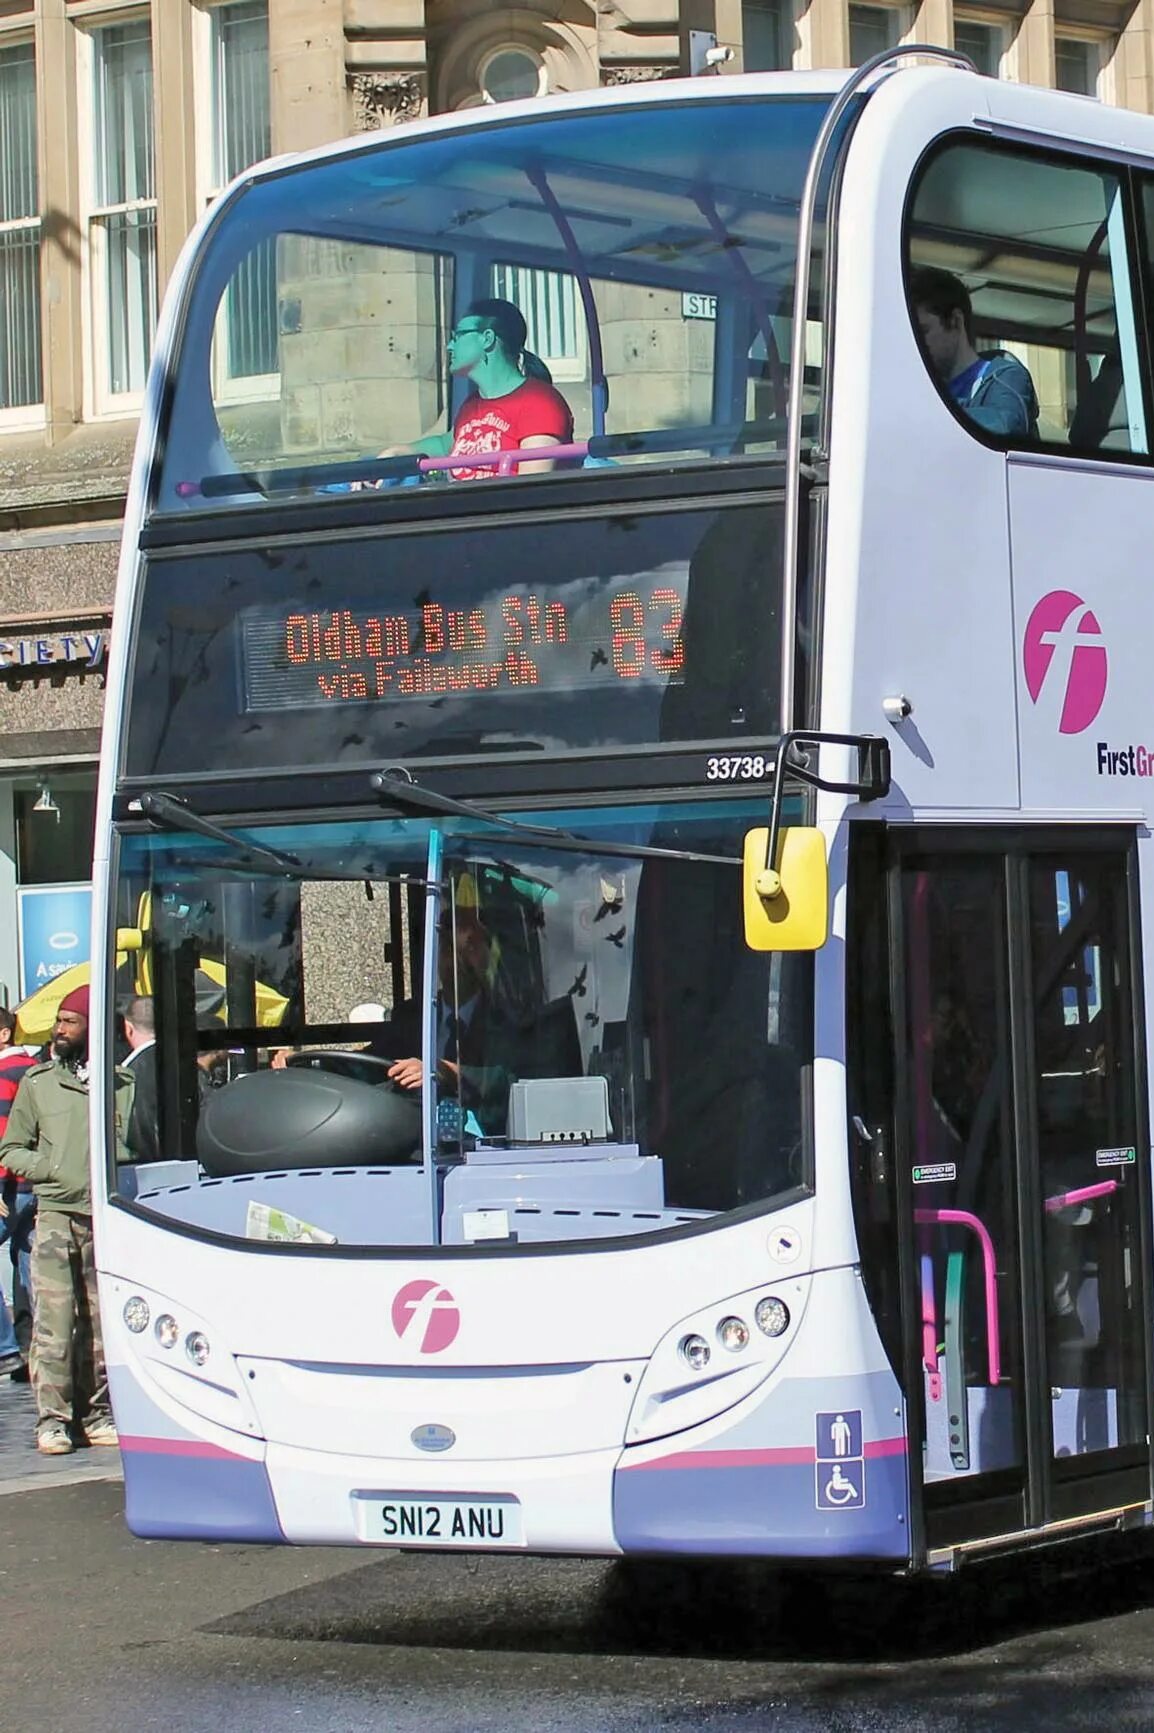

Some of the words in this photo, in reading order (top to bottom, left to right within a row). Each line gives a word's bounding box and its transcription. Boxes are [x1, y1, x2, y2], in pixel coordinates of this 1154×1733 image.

[285, 610, 408, 663] Oldham
[423, 603, 486, 653] Bus
[502, 594, 568, 646] Stn
[610, 587, 685, 678] 83
[317, 665, 368, 699] via
[374, 651, 538, 696] Failsworth
[706, 757, 764, 779] 33738
[382, 1505, 441, 1536] SN12
[451, 1507, 504, 1538] ANU
